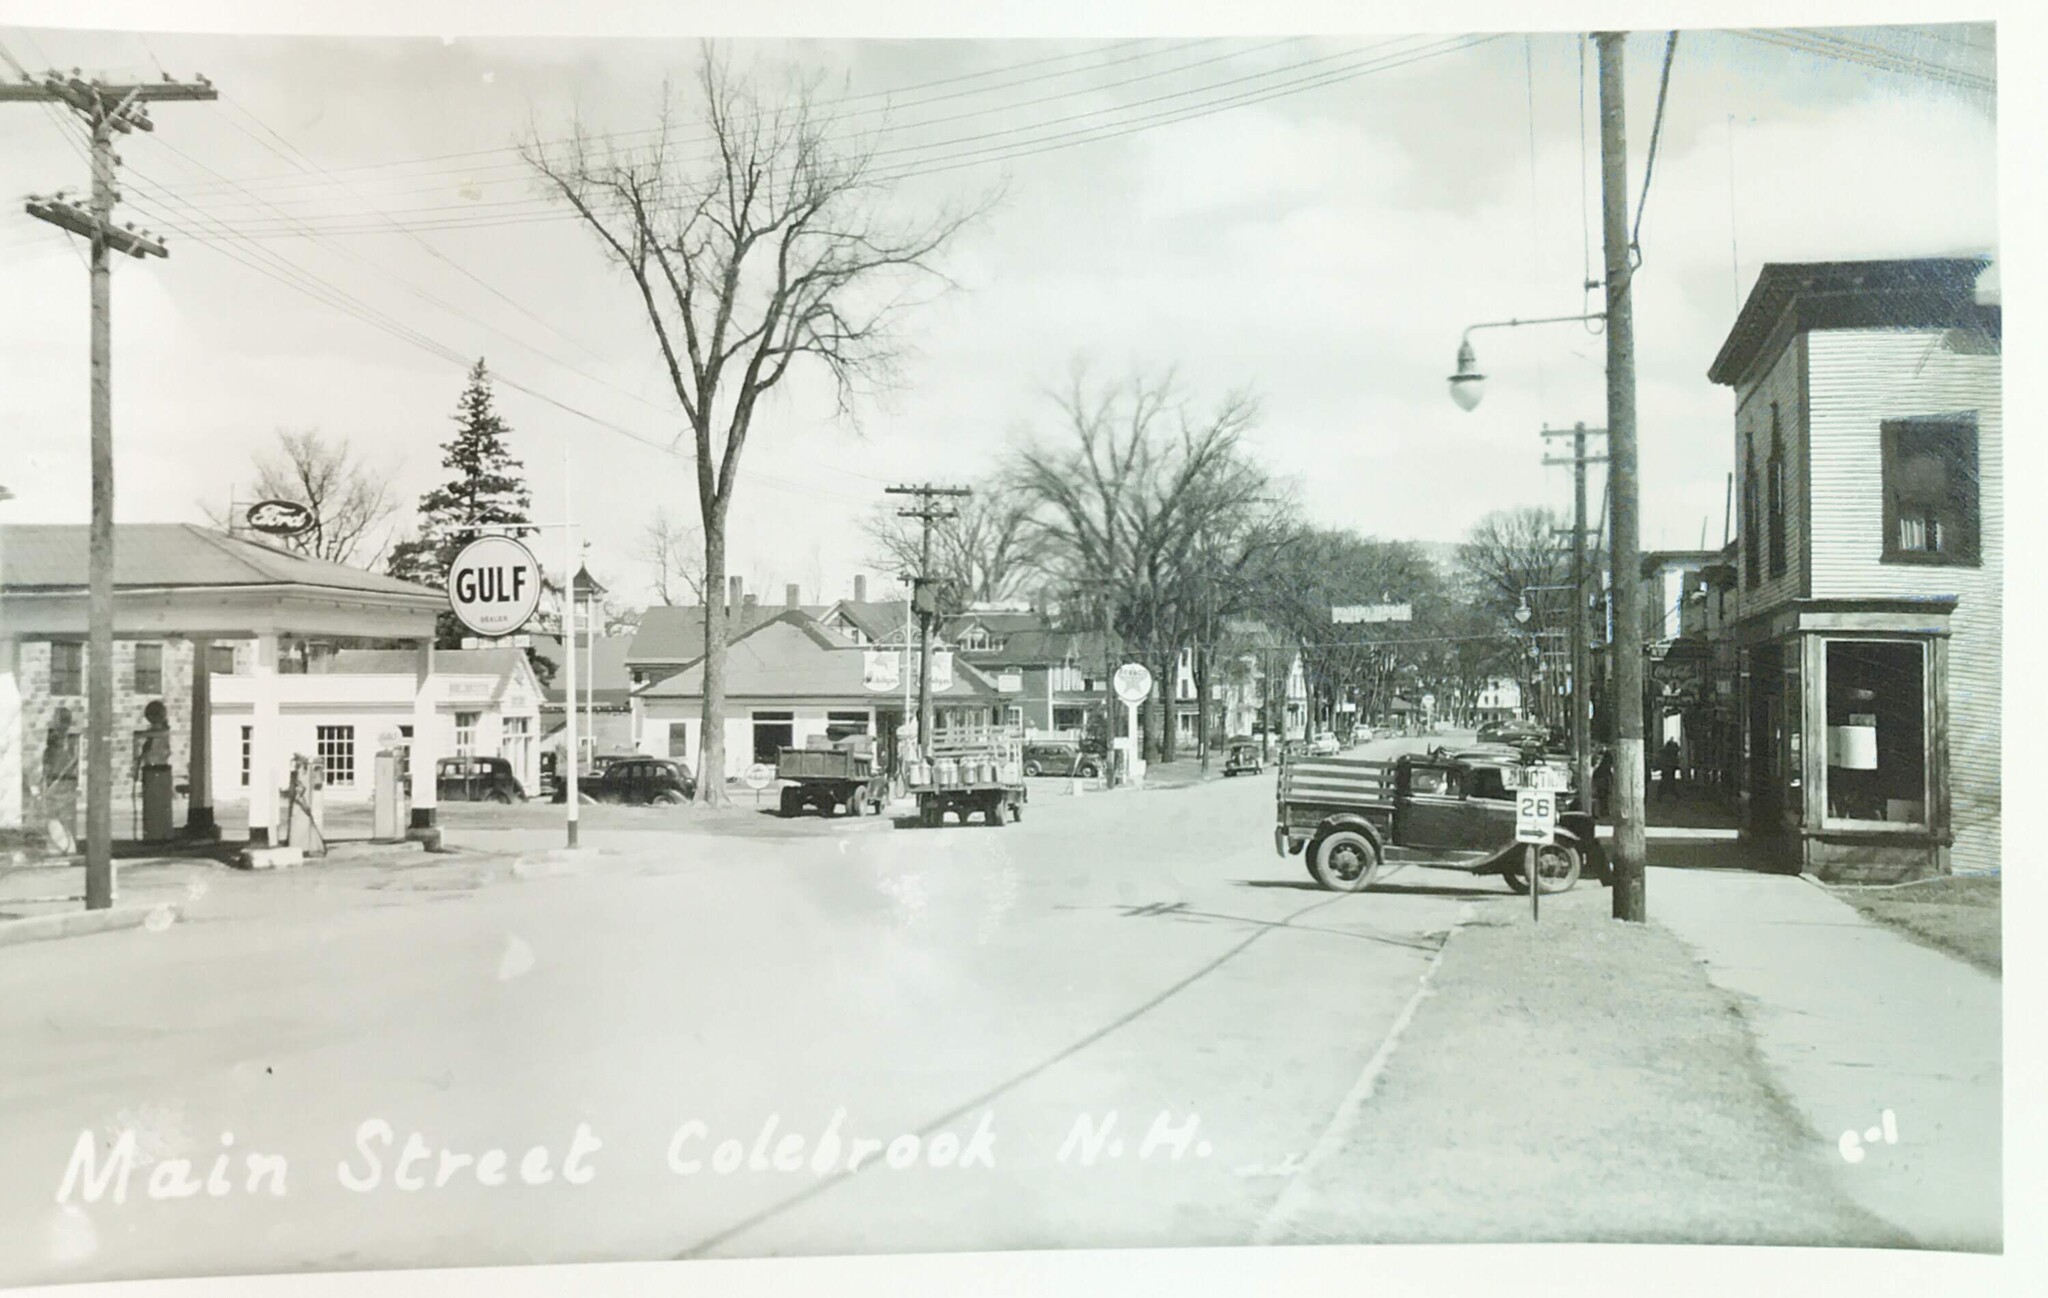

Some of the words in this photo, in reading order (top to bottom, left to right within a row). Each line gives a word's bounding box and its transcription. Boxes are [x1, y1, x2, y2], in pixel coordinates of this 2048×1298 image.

[251, 504, 307, 528] Ford
[456, 566, 527, 604] GULF
[1522, 798, 1550, 818] 26
